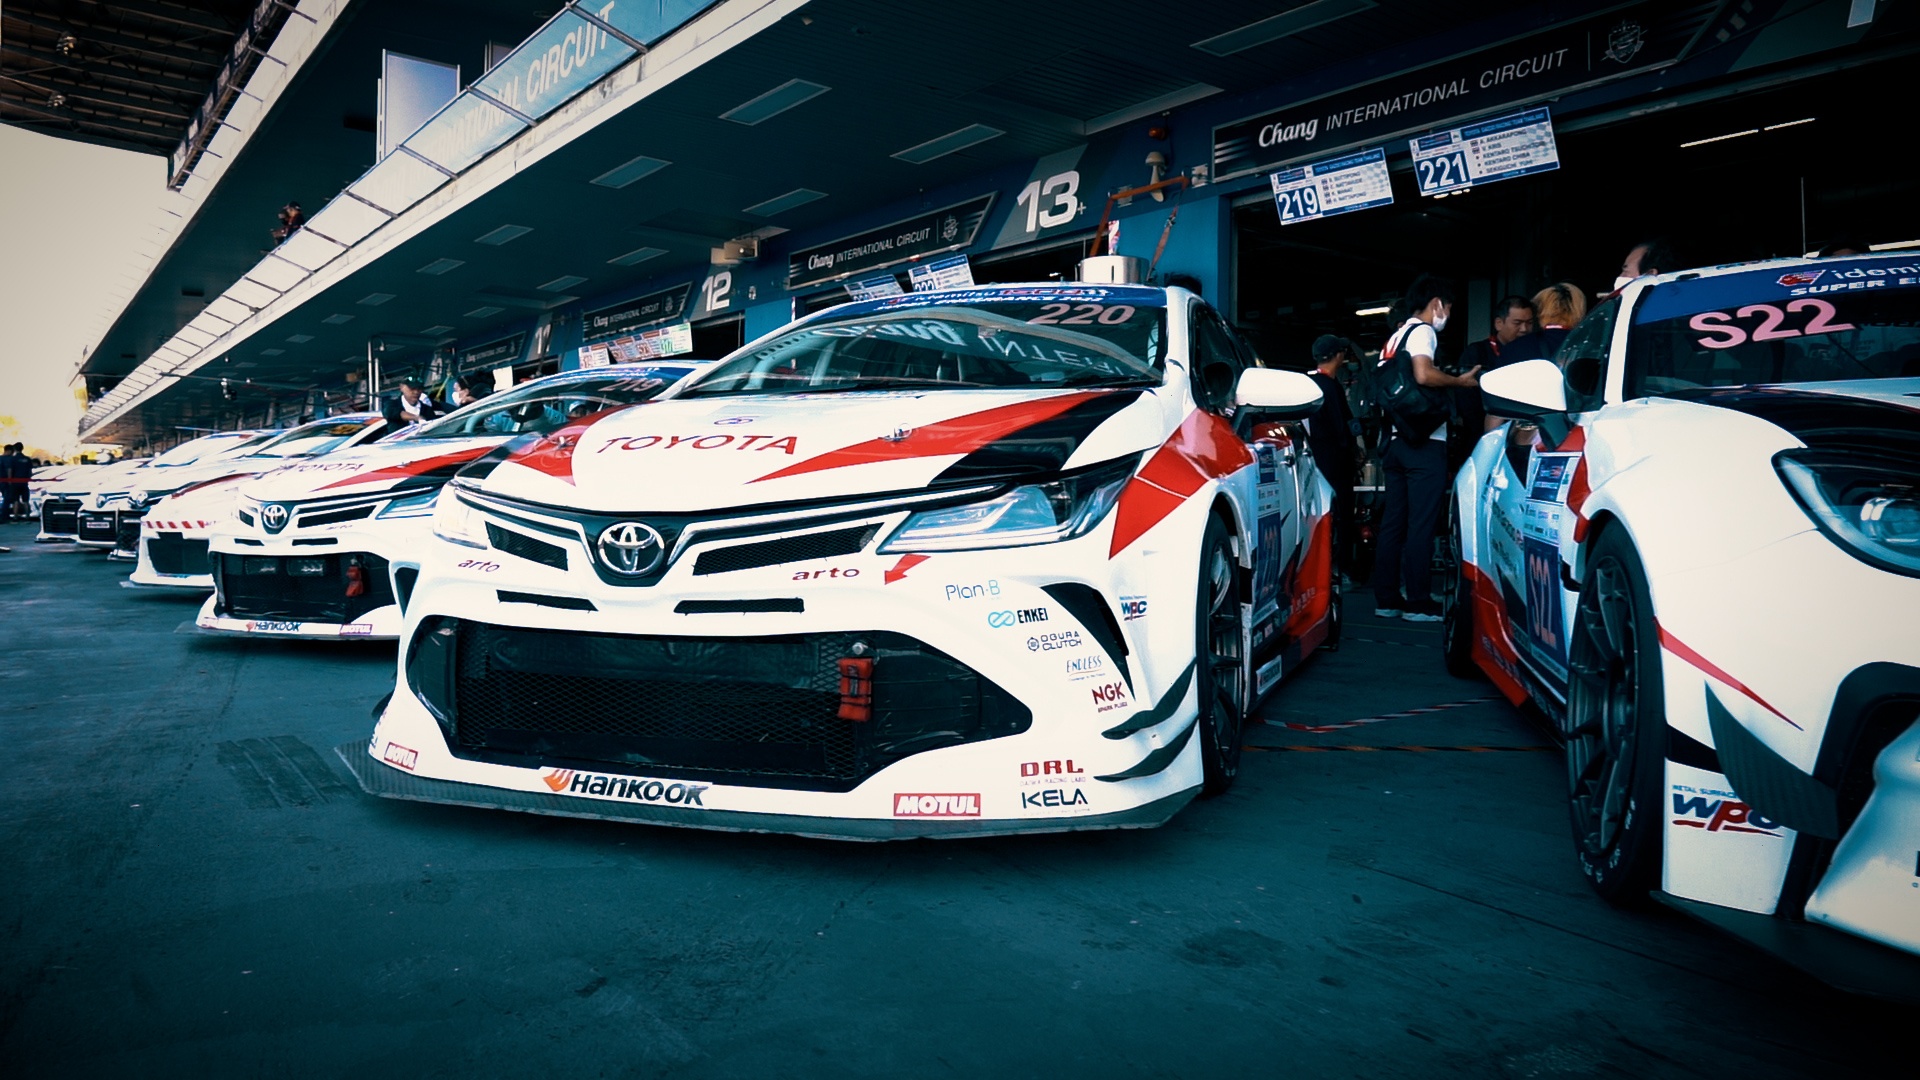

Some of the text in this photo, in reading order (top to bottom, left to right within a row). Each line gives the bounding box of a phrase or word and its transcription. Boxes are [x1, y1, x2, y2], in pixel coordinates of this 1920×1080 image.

[527, 1, 615, 102] CIRCUIT
[1259, 48, 1568, 147] Chang INTERNATIONAL CIRCUIT
[1420, 153, 1467, 190] 221
[1016, 170, 1080, 233] 13
[1279, 188, 1318, 219] 219
[808, 228, 931, 270] Chang INTERNATIONAL CIRCUIT
[702, 271, 732, 312] 12
[1790, 279, 1886, 296] SUPER
[1025, 303, 1136, 325] 220
[1689, 298, 1856, 349] S22
[598, 378, 665, 392] 219
[597, 435, 798, 455] TOYOTA
[458, 559, 500, 573] arto
[792, 567, 860, 581] arto
[1017, 607, 1049, 624] ENKEI
[1041, 631, 1080, 643] OGURA
[1043, 639, 1082, 651] CLUTCH
[1067, 655, 1102, 673] ENDLESS
[1091, 681, 1125, 705] NGK
[1021, 759, 1084, 777] DRL
[896, 795, 980, 815] MOTUL
[1022, 788, 1088, 809] KELA
